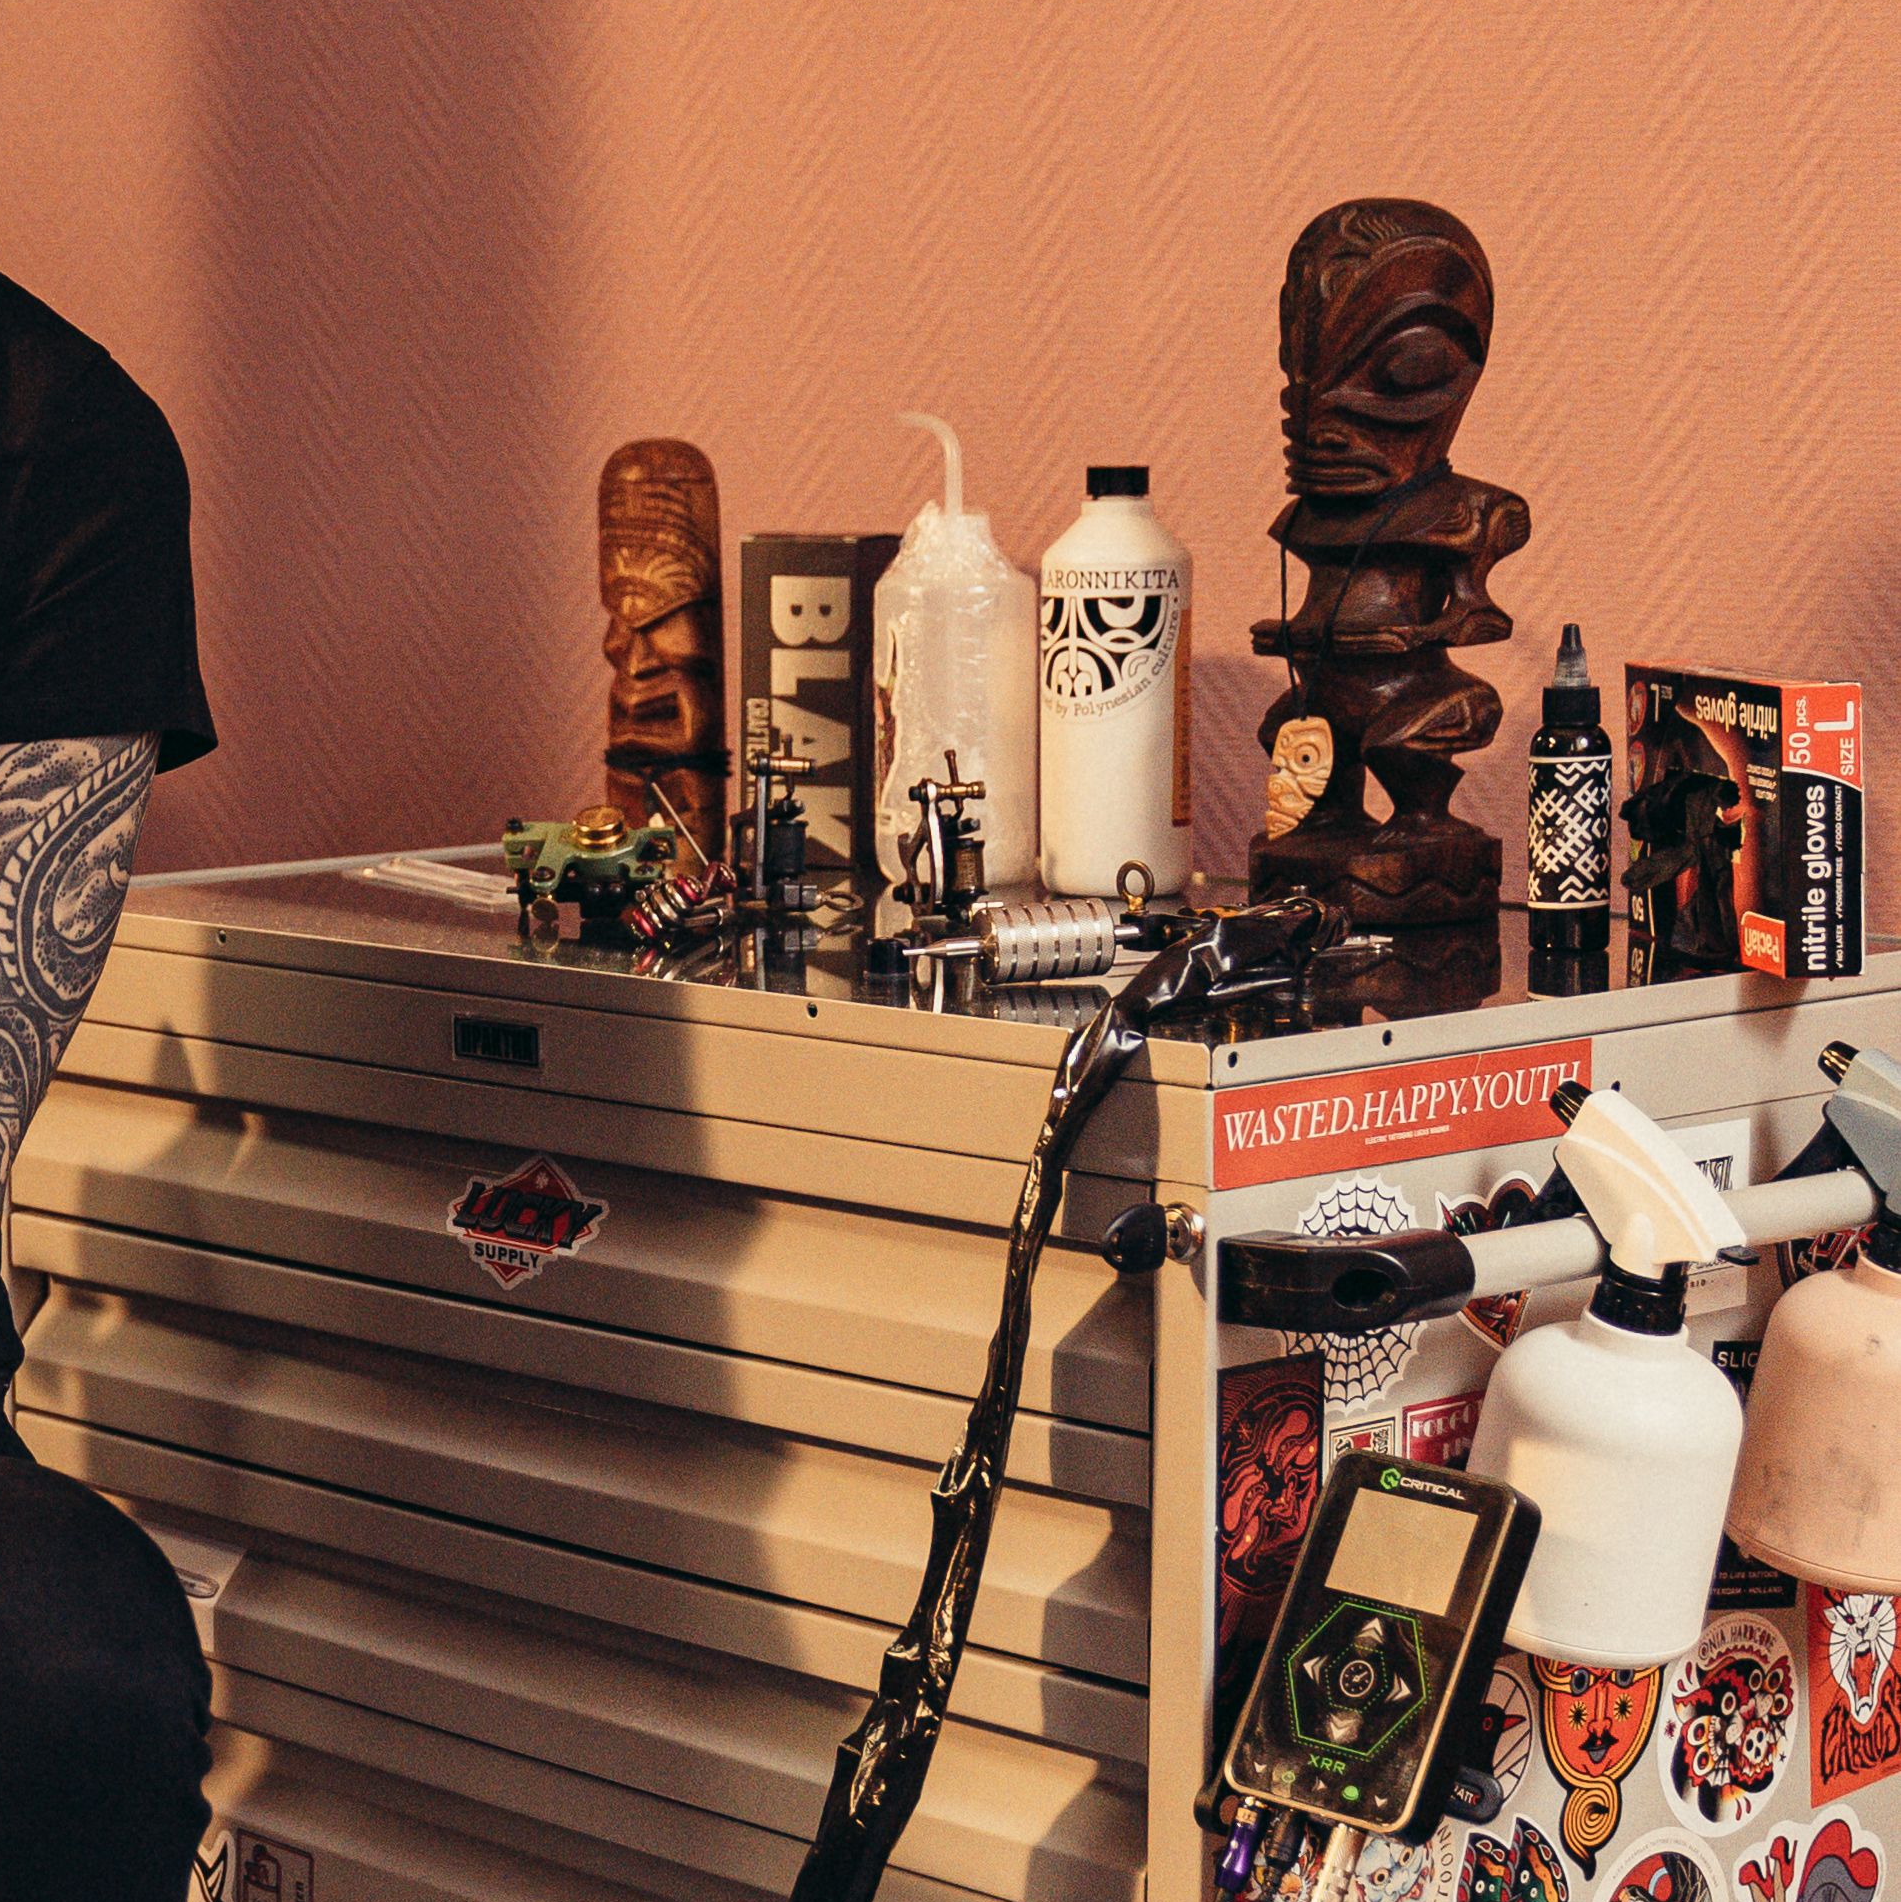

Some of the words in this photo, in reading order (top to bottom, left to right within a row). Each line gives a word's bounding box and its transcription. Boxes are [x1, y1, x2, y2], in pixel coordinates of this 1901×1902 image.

[1694, 690, 1737, 733] gloves
[1738, 701, 1779, 741] nitrile
[1813, 700, 1855, 732] L
[1788, 731, 1811, 765] 50
[1839, 736, 1855, 777] SIZE
[1801, 784, 1832, 880] gloves
[1801, 886, 1826, 972] nitrile
[452, 1182, 603, 1250] LUCKY
[474, 1242, 540, 1269] SUPPLY
[1717, 1350, 1758, 1369] SLIC
[1399, 1476, 1466, 1501] CRITICAL
